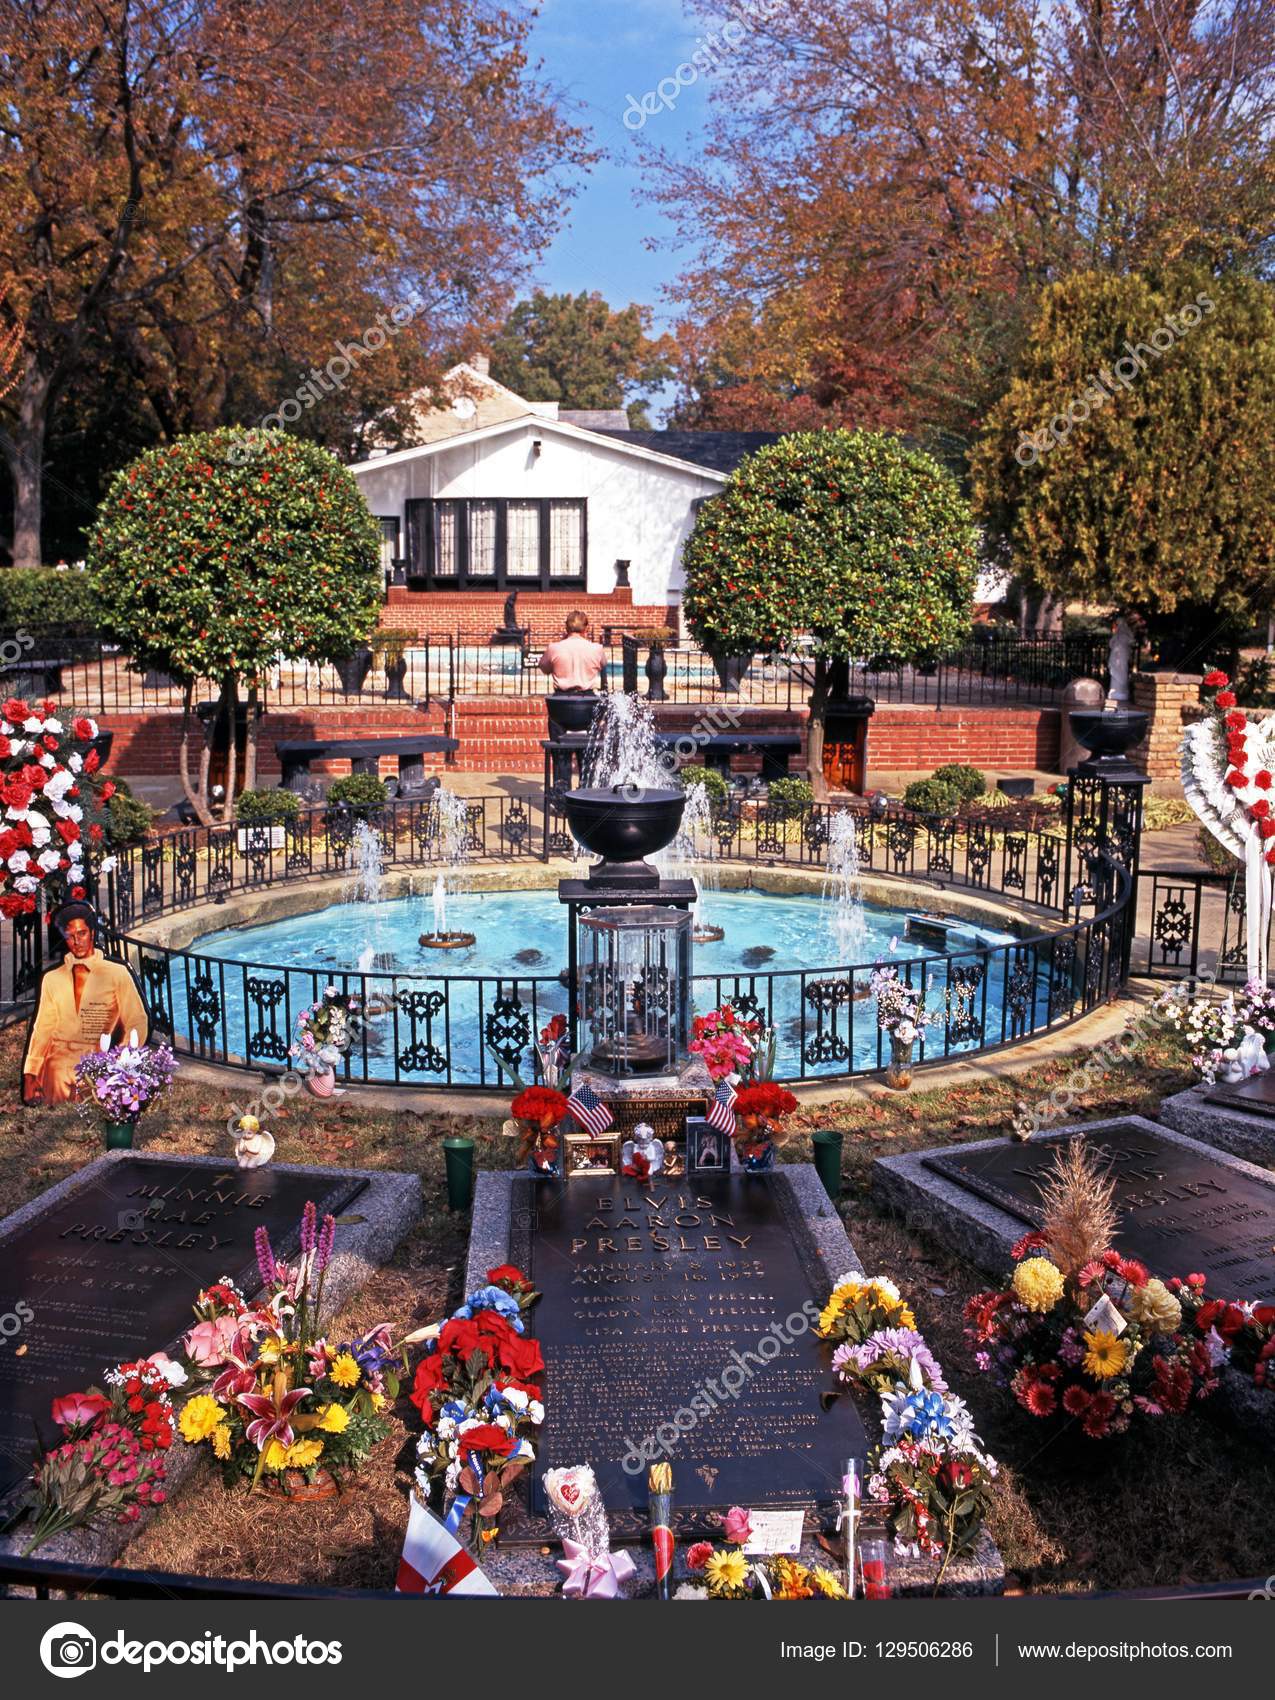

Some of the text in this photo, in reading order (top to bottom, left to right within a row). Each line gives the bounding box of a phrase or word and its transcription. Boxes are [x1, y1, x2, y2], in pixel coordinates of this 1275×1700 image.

[126, 1184, 272, 1208] MINNIE
[597, 1195, 713, 1211] ELVIS
[137, 1204, 217, 1225] MAE
[586, 1214, 736, 1230] AARON
[59, 1222, 233, 1252] PRESLEY
[571, 1234, 753, 1255] PRESLEY
